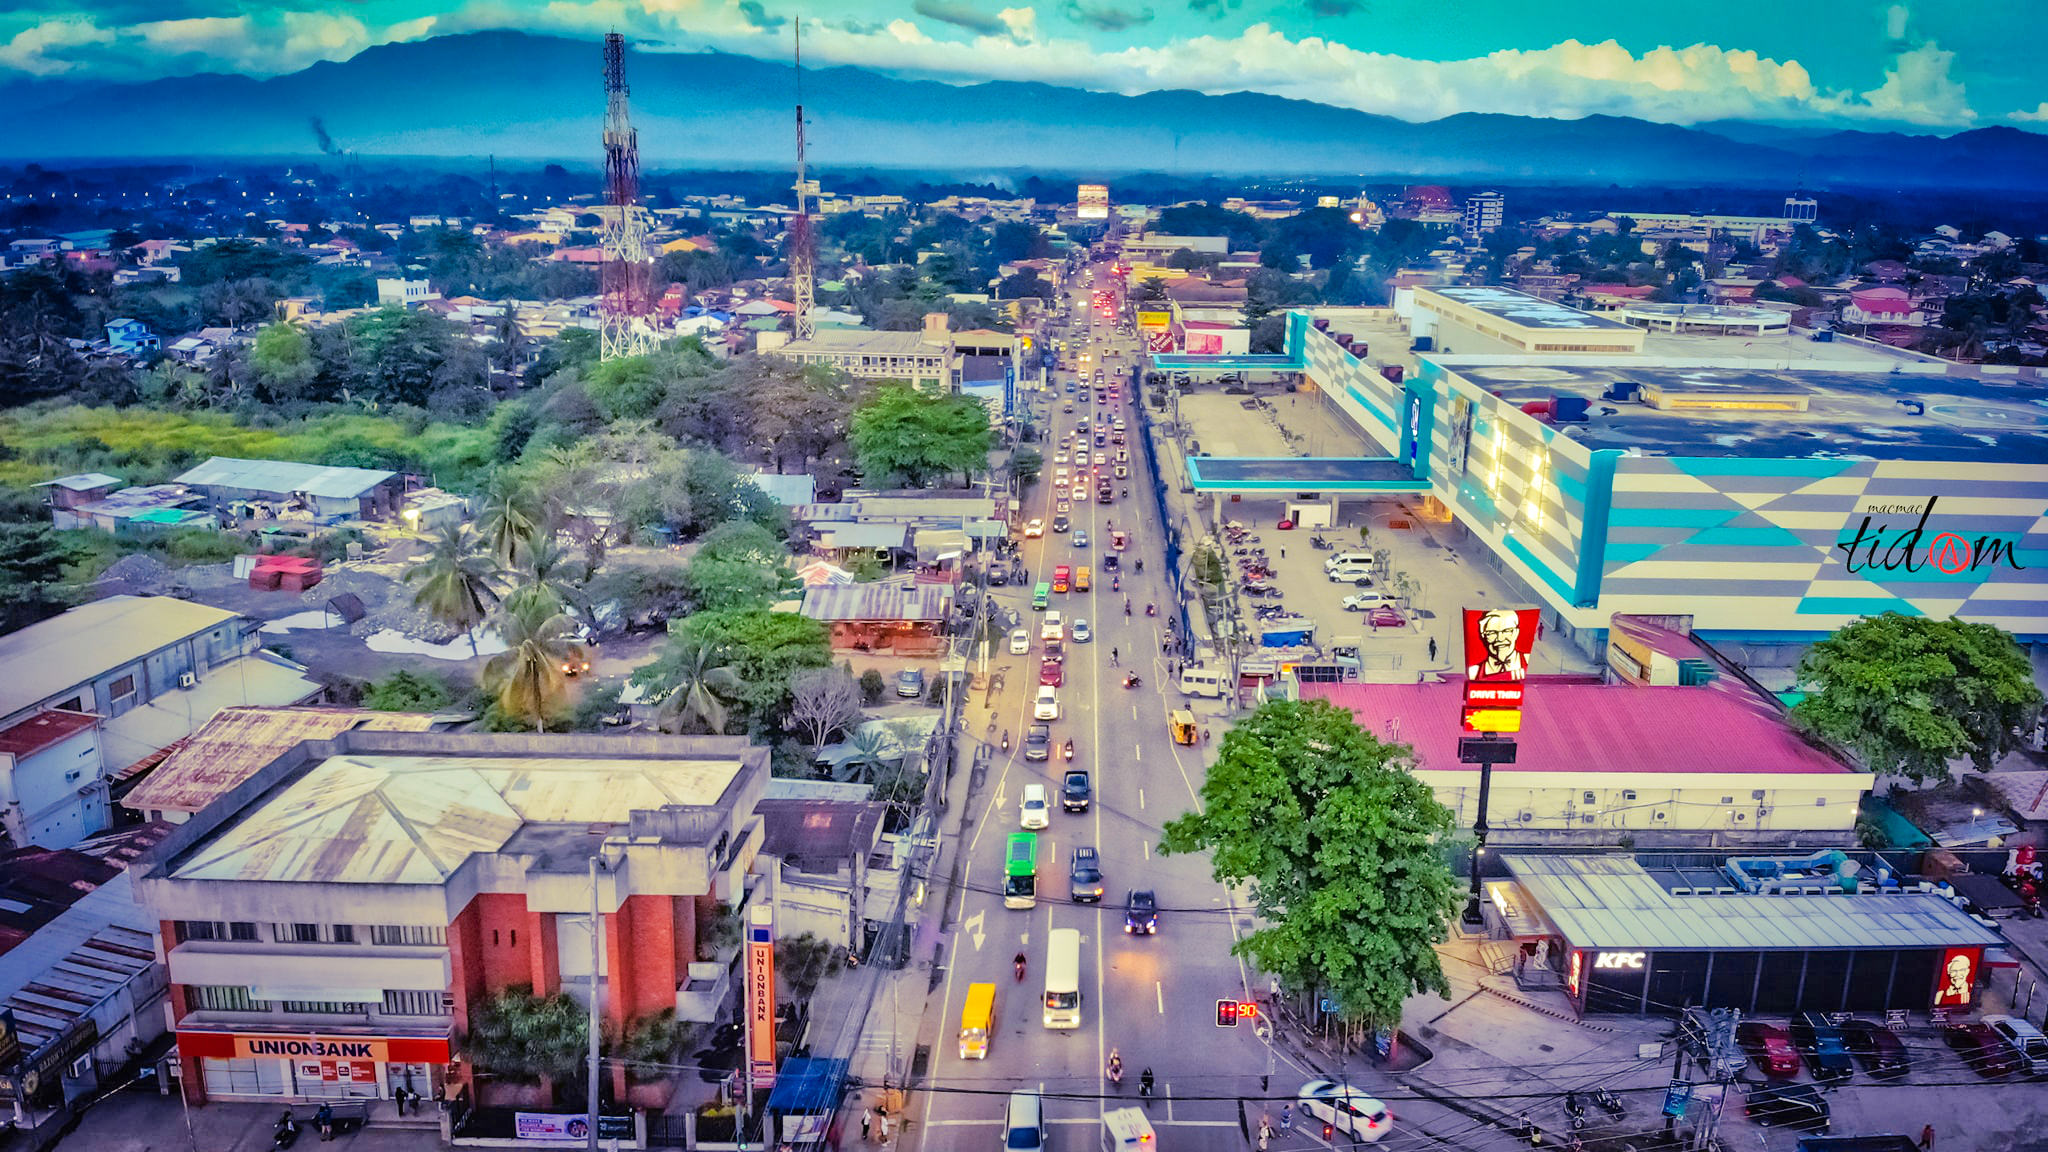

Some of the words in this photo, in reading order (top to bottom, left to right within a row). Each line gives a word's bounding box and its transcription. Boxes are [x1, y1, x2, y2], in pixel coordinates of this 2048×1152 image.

[1470, 690, 1496, 699] DRIVE
[1497, 690, 1521, 699] THRU
[1594, 951, 1647, 968] KFC
[756, 950, 766, 1021] UNIONBANK
[1239, 1004, 1256, 1017] 90
[249, 1040, 373, 1058] UNIONBANK
